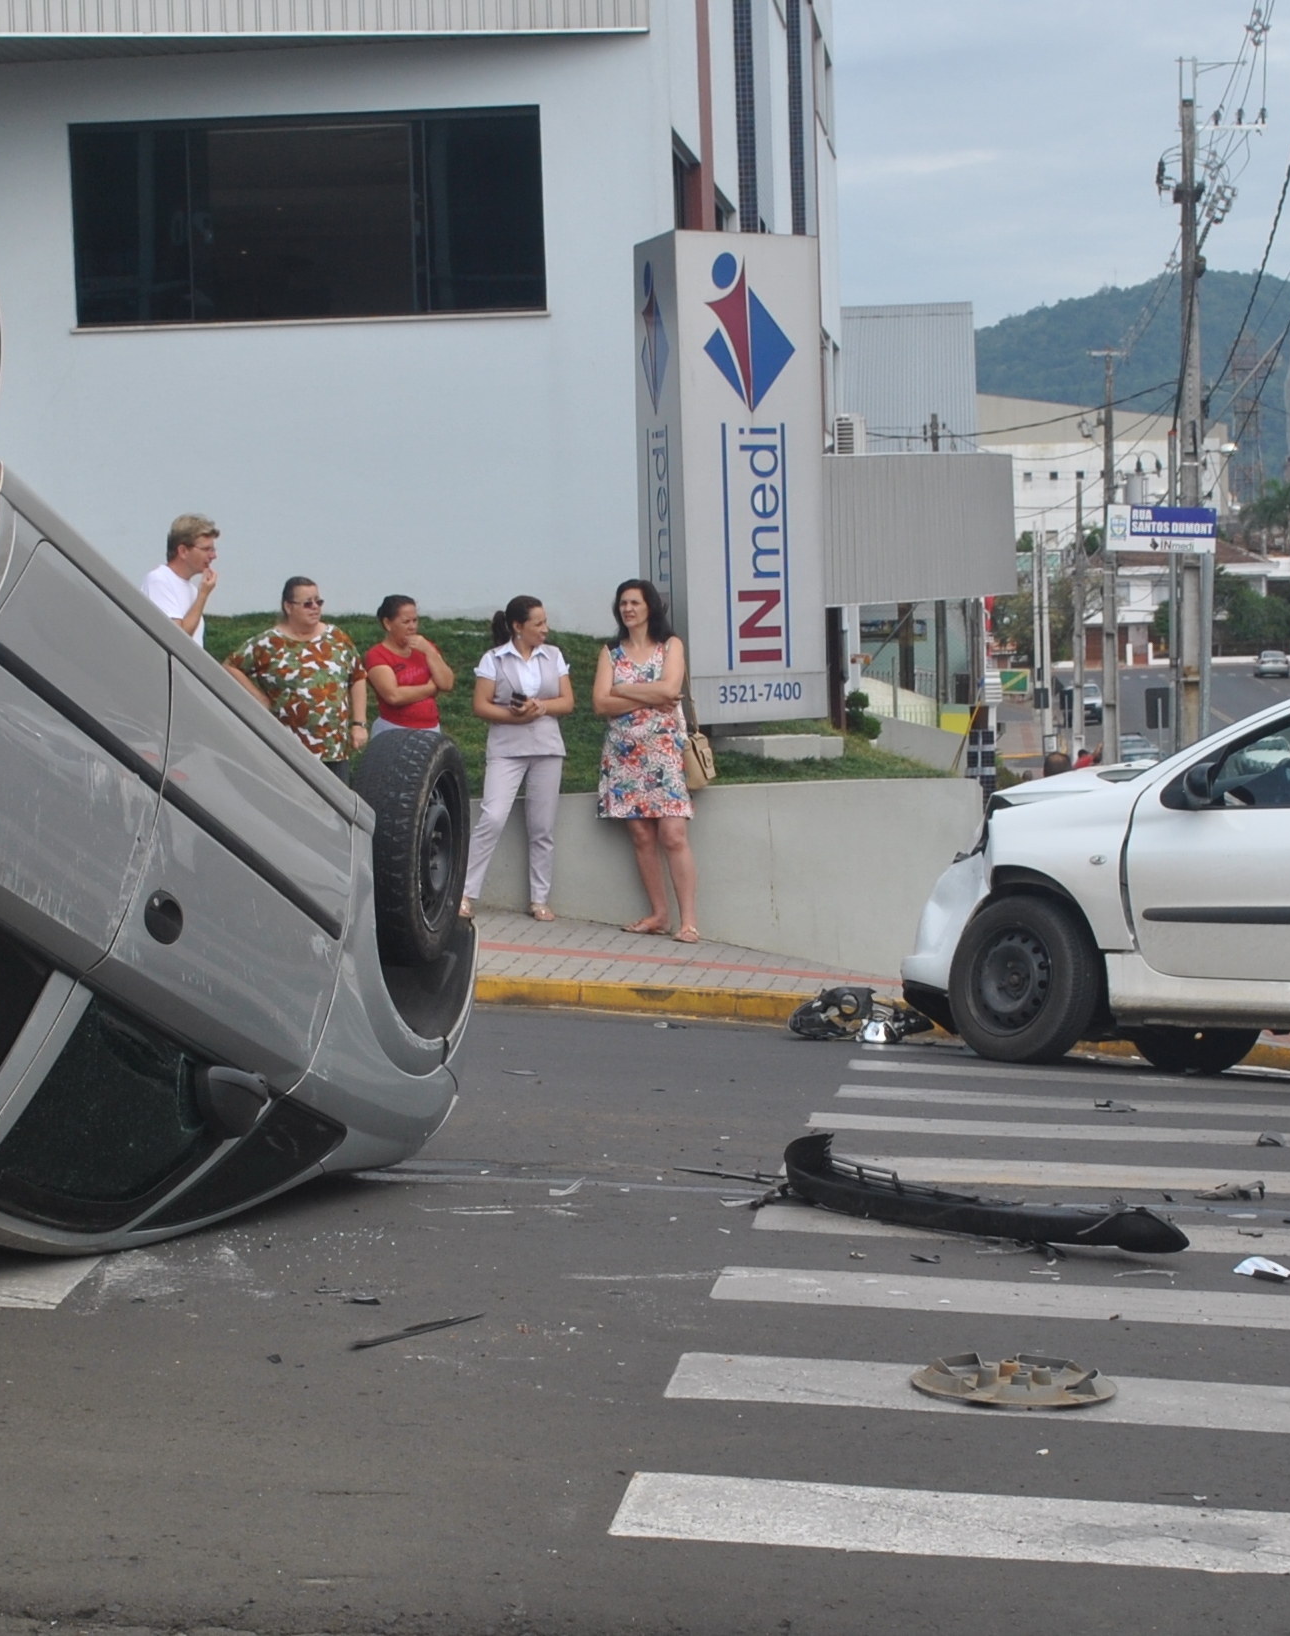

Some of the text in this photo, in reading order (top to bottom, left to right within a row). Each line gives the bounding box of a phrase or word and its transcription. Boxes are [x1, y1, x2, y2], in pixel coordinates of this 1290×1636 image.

[1132, 509, 1153, 520] RUA
[1131, 521, 1214, 535] SANTOS DUMONT
[737, 426, 783, 663] INmedi
[1160, 540, 1195, 550] INmedi
[719, 682, 802, 704] 3521-7400
